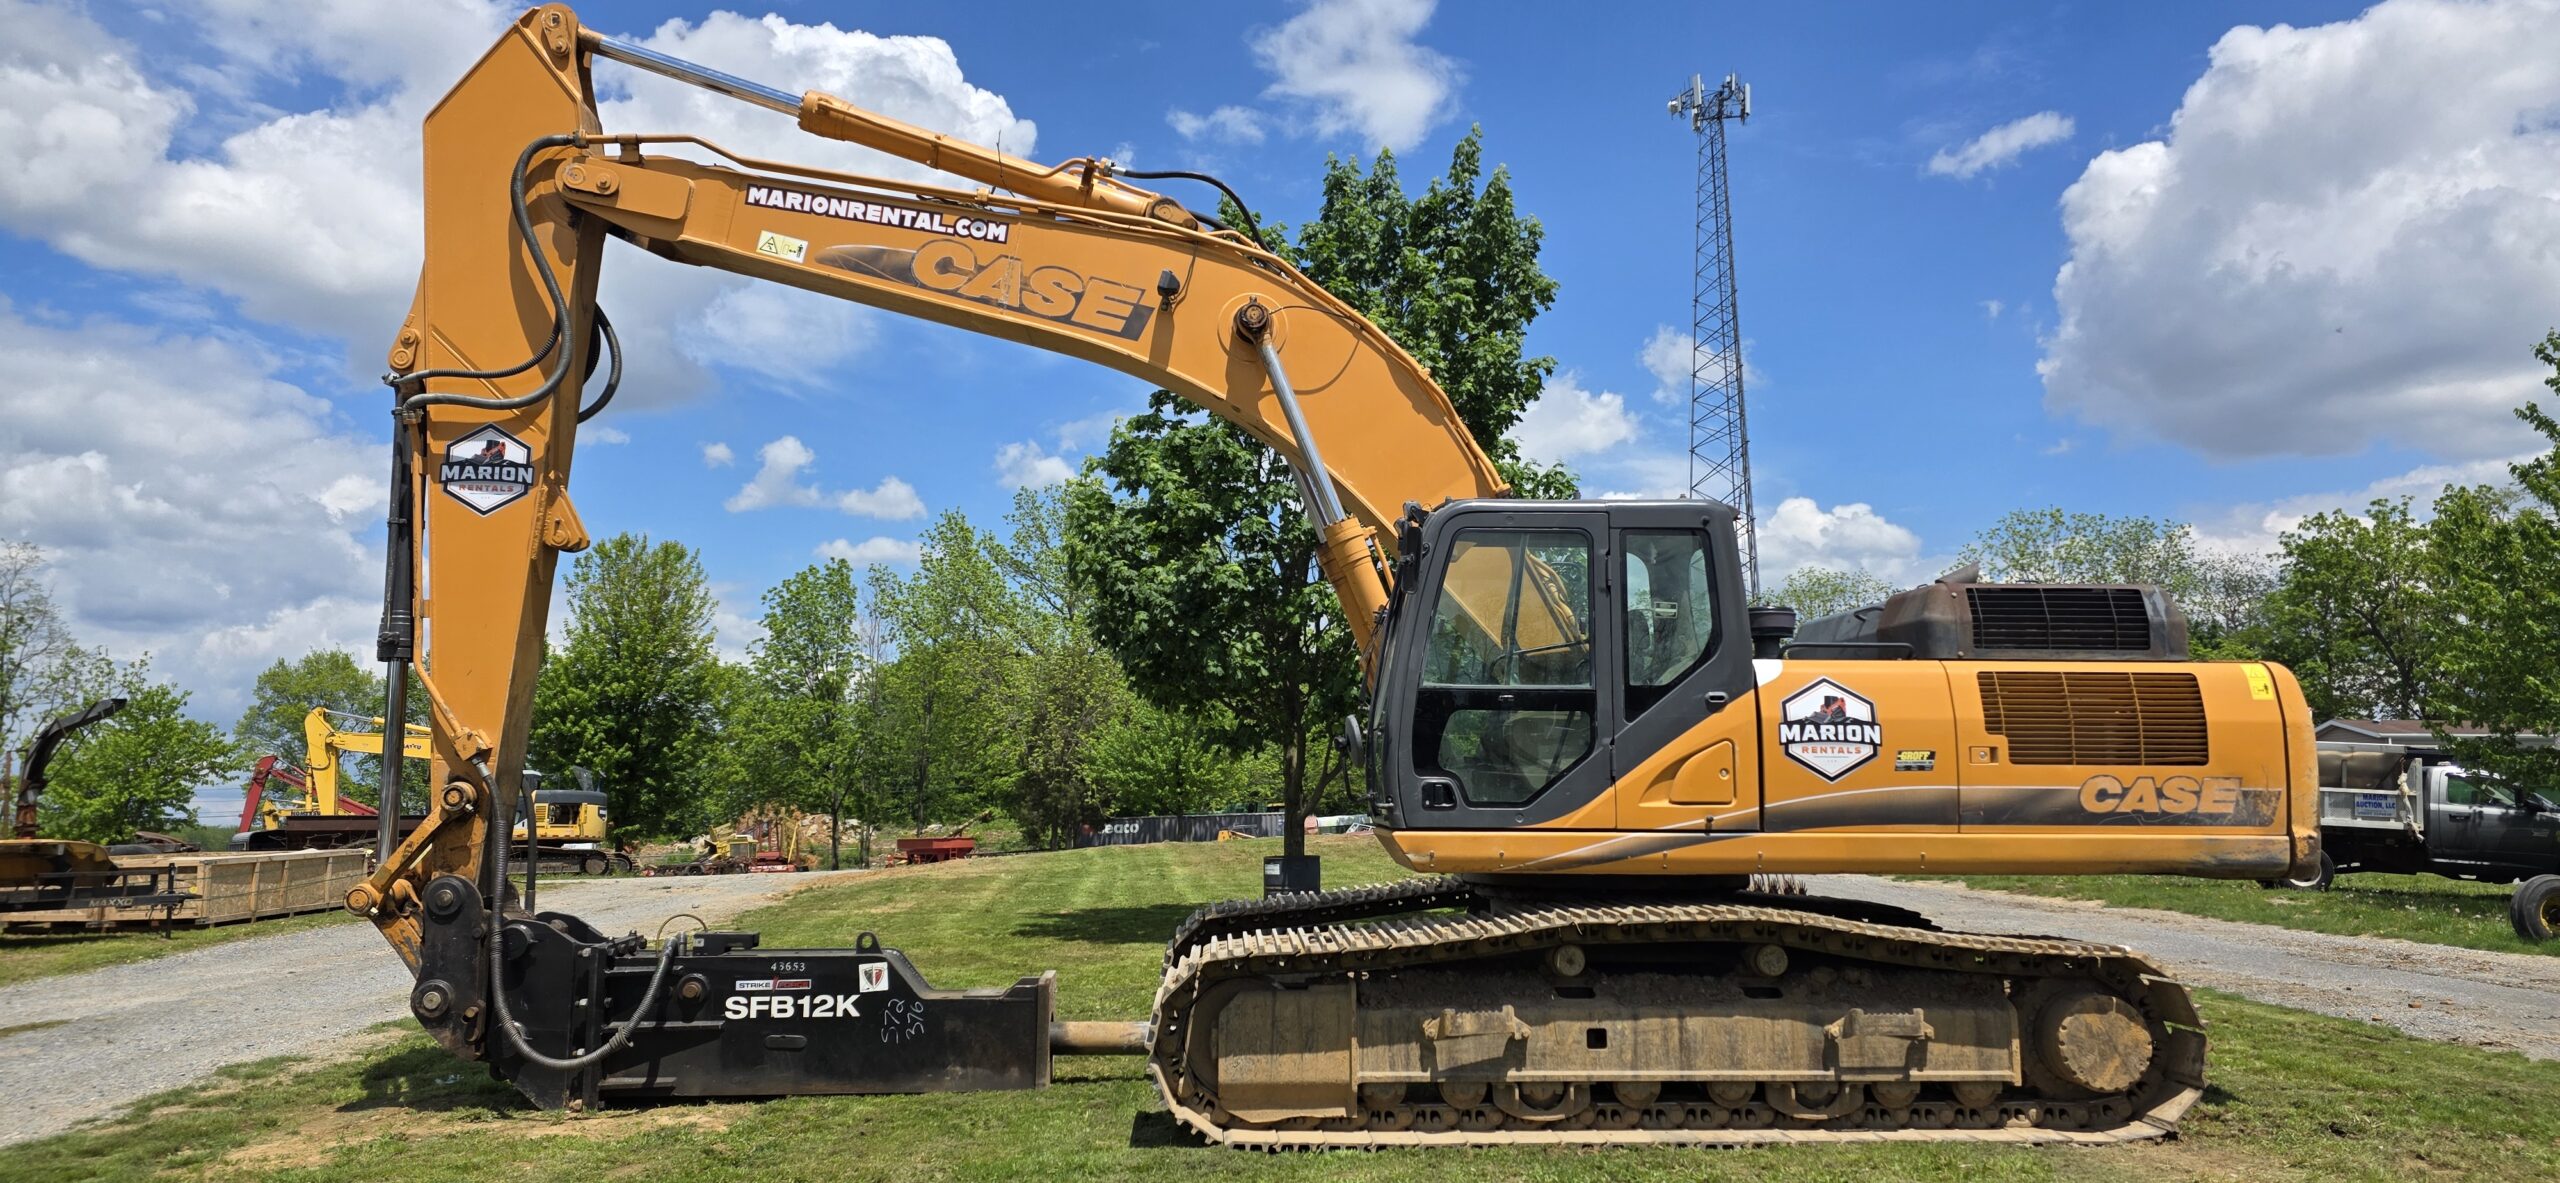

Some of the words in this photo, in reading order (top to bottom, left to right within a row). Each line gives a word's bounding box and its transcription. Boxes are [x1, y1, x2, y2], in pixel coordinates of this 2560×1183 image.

[747, 186, 1007, 242] MARIONRENTAL.COM
[911, 239, 1146, 334] CASE
[440, 465, 533, 483] MARION
[459, 484, 514, 492] RENTALS
[1780, 724, 1881, 744] MARION
[1802, 746, 1862, 754] RENTALS
[2079, 775, 2242, 814] CASE
[1097, 823, 1140, 834] eaco
[725, 994, 861, 1020] SFB12K
